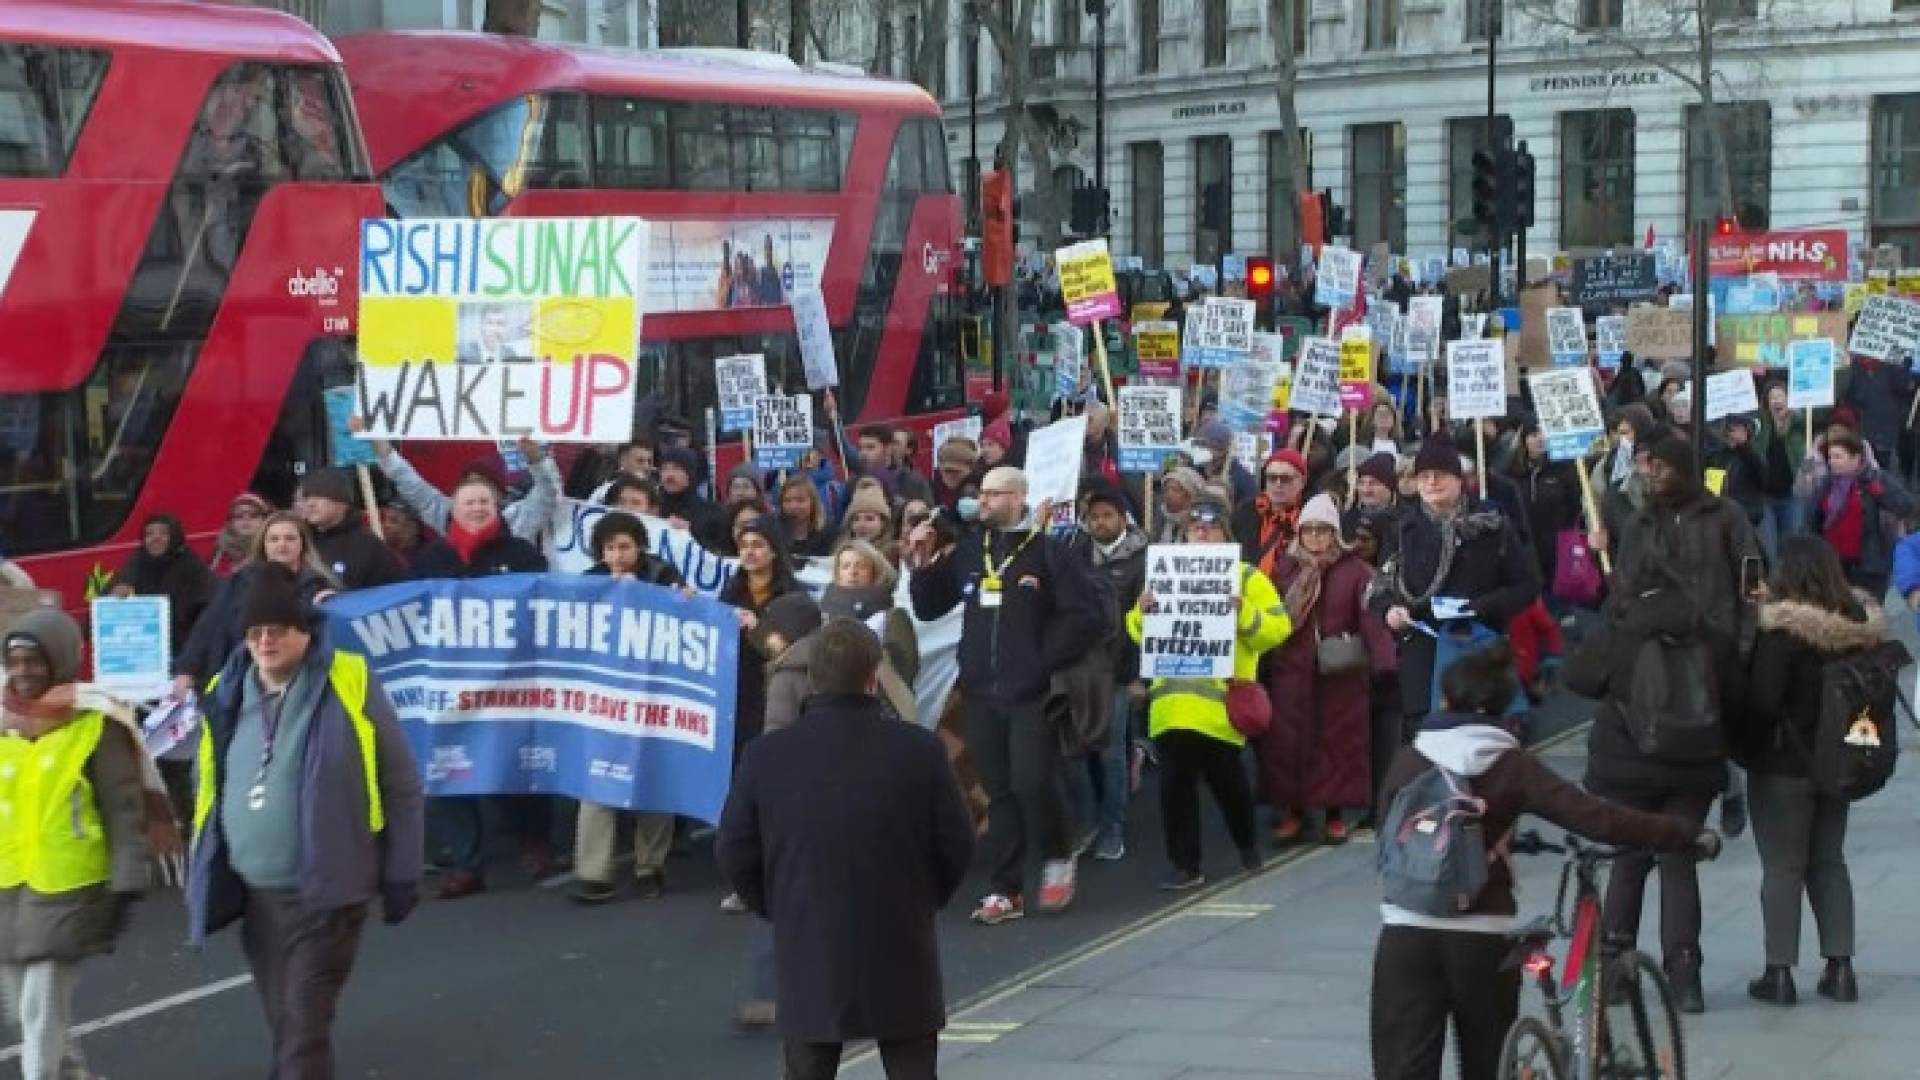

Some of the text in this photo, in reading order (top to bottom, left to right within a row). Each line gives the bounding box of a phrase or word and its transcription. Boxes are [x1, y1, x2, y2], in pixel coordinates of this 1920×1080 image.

[1611, 72, 1658, 86] PLACE
[361, 219, 634, 297] RISHI SUNAK
[1768, 240, 1828, 263] NHS
[358, 353, 631, 436] WAKE UP
[756, 398, 799, 415] STRIKE
[1120, 396, 1168, 412] STRIKE
[756, 414, 773, 429] TO
[778, 412, 808, 429] SAVE
[1121, 412, 1174, 428] TO SAVE
[757, 428, 808, 444] THE NHS
[1121, 429, 1177, 446] THE NHS
[1153, 556, 1235, 575] A VICTORY
[1150, 577, 1232, 594] FOR NURSES
[1163, 602, 1173, 614] A
[351, 599, 720, 676] WE ARE THE NHS!
[1172, 620, 1203, 638] FOR
[1144, 637, 1234, 657] EVERYONE
[457, 687, 556, 711] STRIKING
[561, 690, 586, 712] TO
[588, 692, 628, 722] SAVE
[634, 701, 669, 727] THE
[674, 708, 709, 737] NHS
